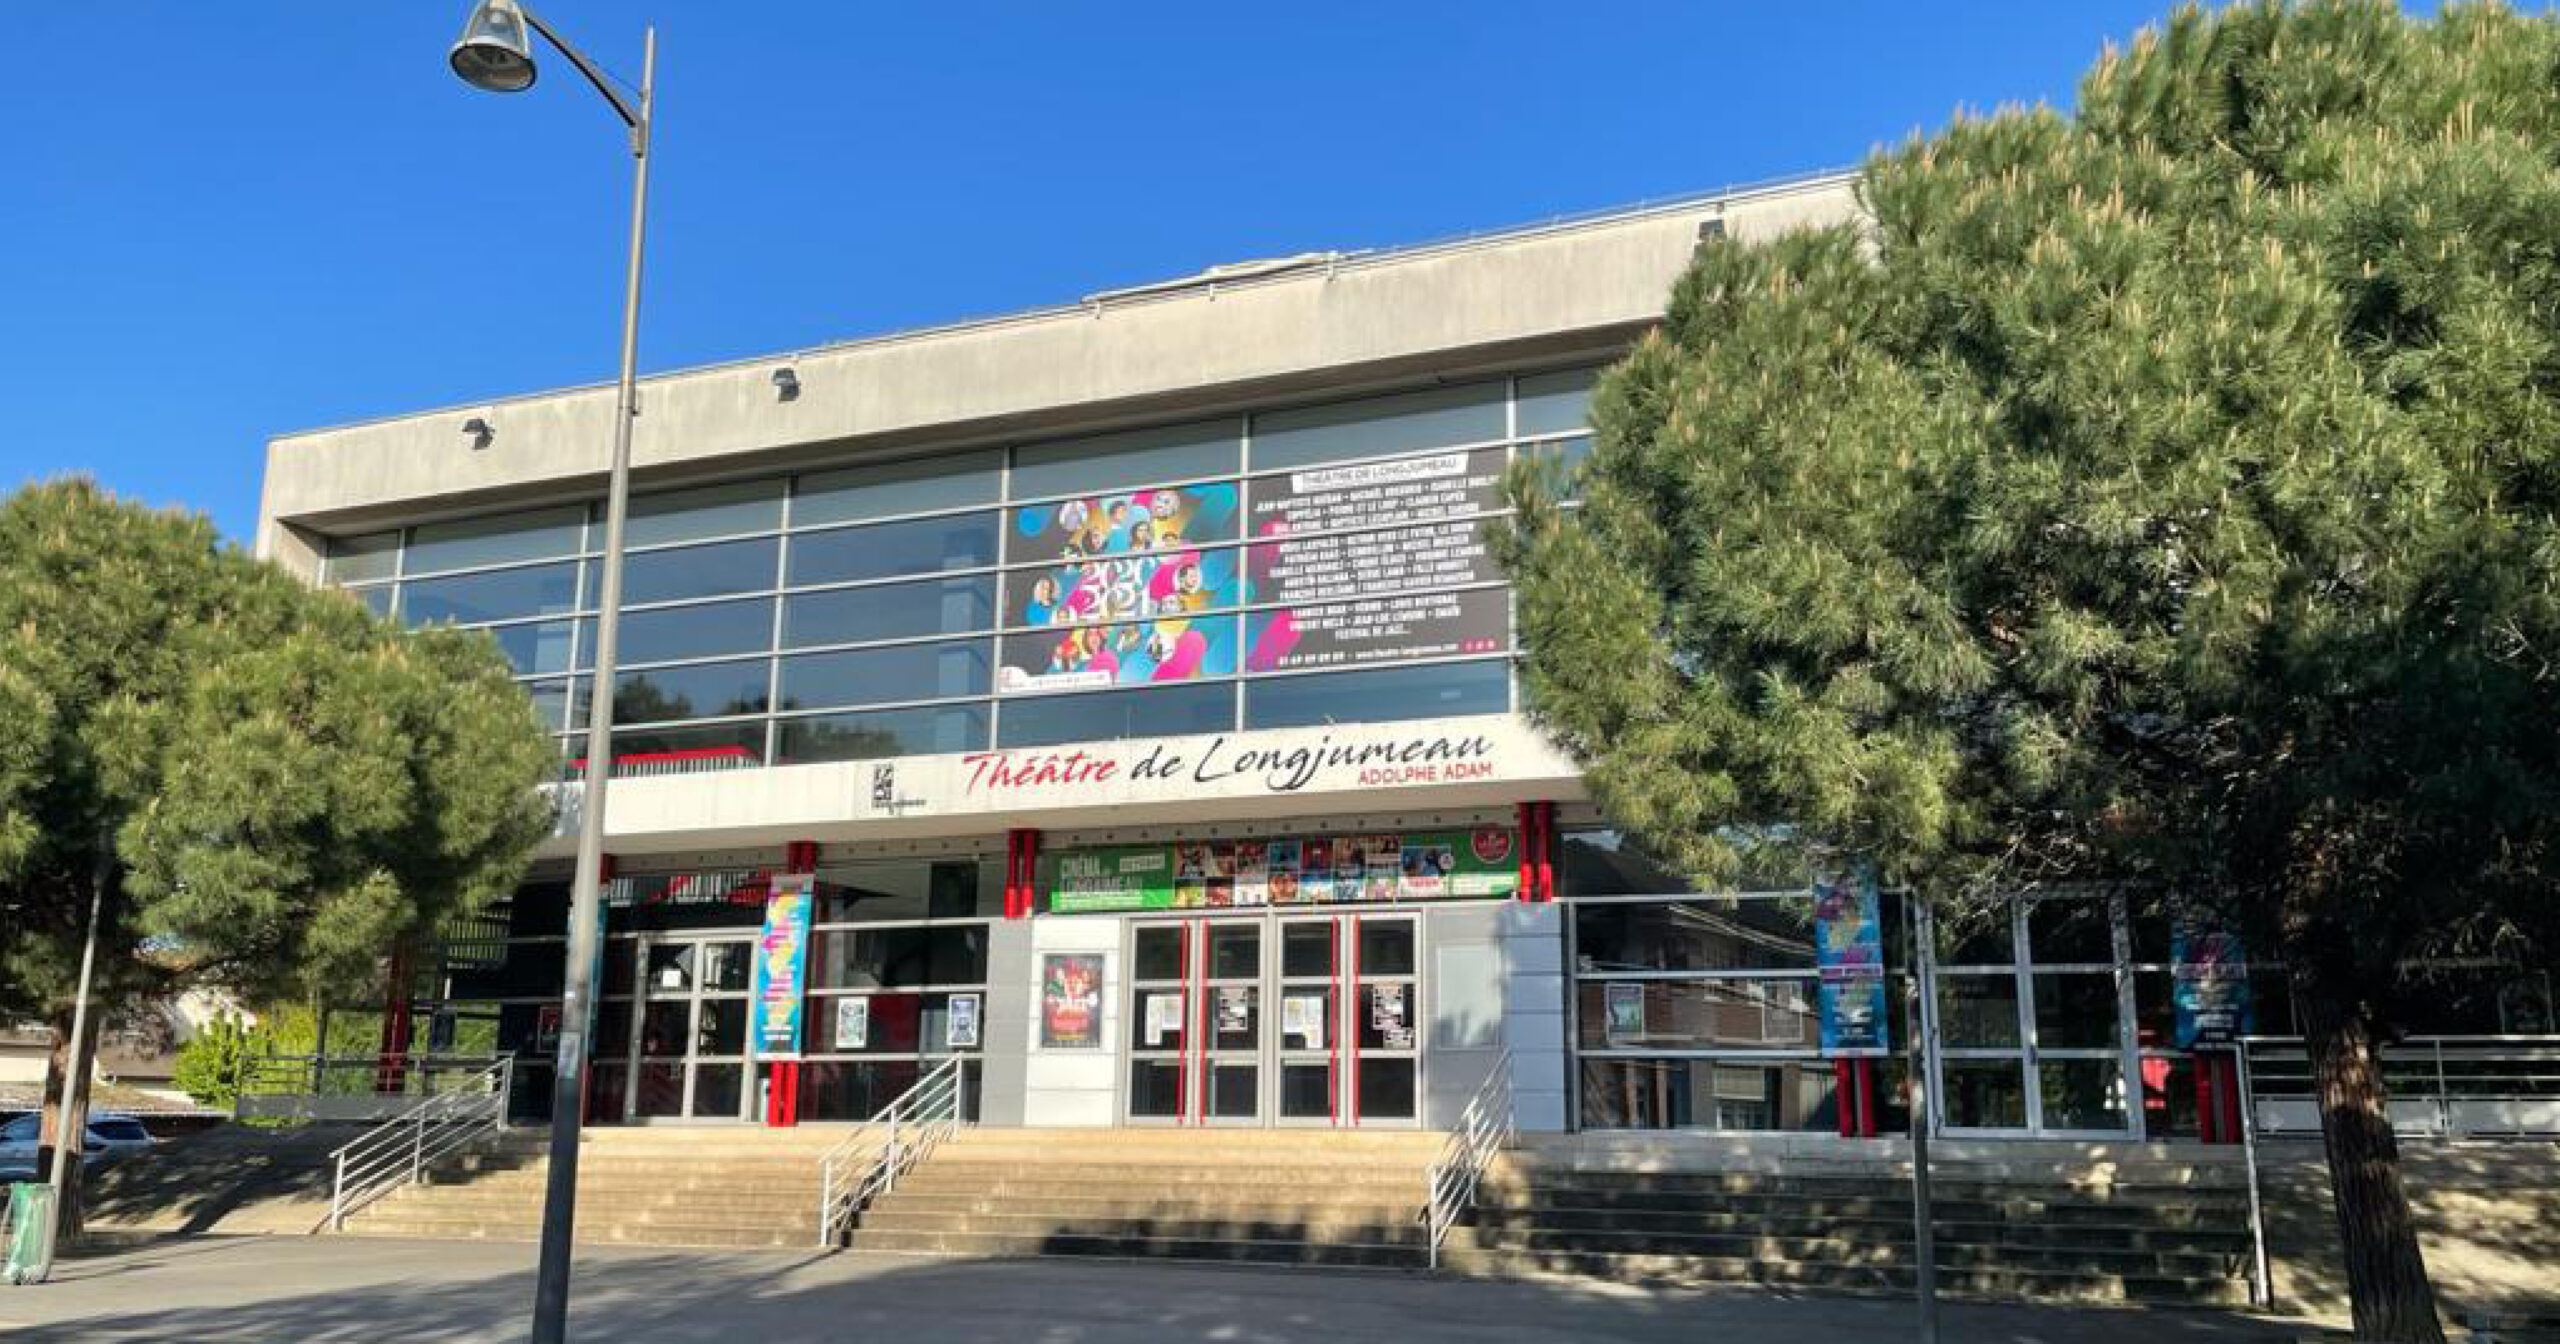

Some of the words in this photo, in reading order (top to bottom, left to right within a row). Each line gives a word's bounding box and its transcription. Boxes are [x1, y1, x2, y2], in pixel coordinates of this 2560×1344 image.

[963, 749, 1118, 794] Théâtre
[1130, 744, 1184, 780] de
[1194, 735, 1494, 792] Longjumeau
[1358, 767, 1436, 786] ADOLPHE
[1443, 762, 1492, 780] ADAM
